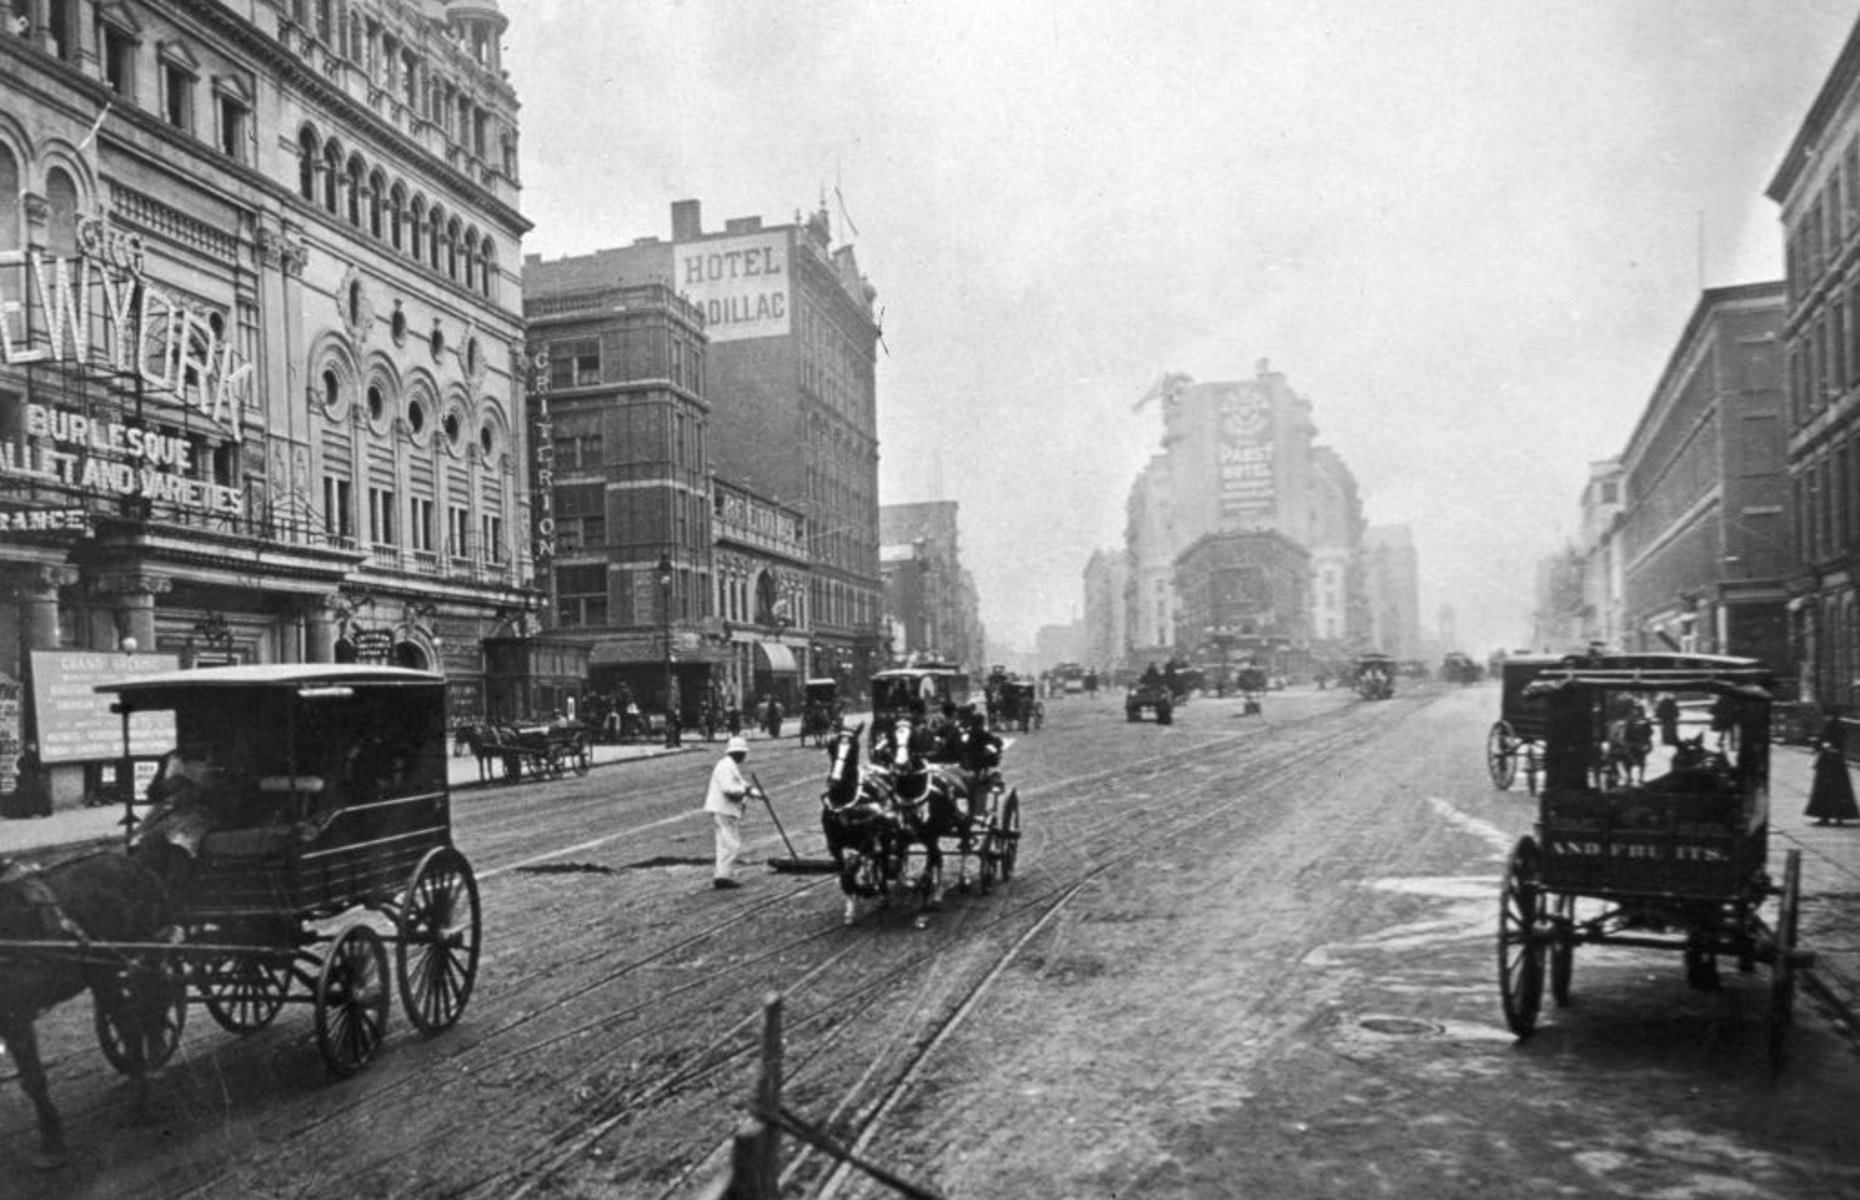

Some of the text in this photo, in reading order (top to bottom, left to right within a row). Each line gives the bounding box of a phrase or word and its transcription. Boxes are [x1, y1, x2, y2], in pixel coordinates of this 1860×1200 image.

[684, 246, 781, 284] HOTEL
[696, 291, 785, 326] DILLAC
[93, 259, 252, 443] YORK
[26, 403, 192, 469] BURLESQUE
[535, 351, 555, 556] CRITERION
[0, 442, 243, 514] LLET AND VARIETIES
